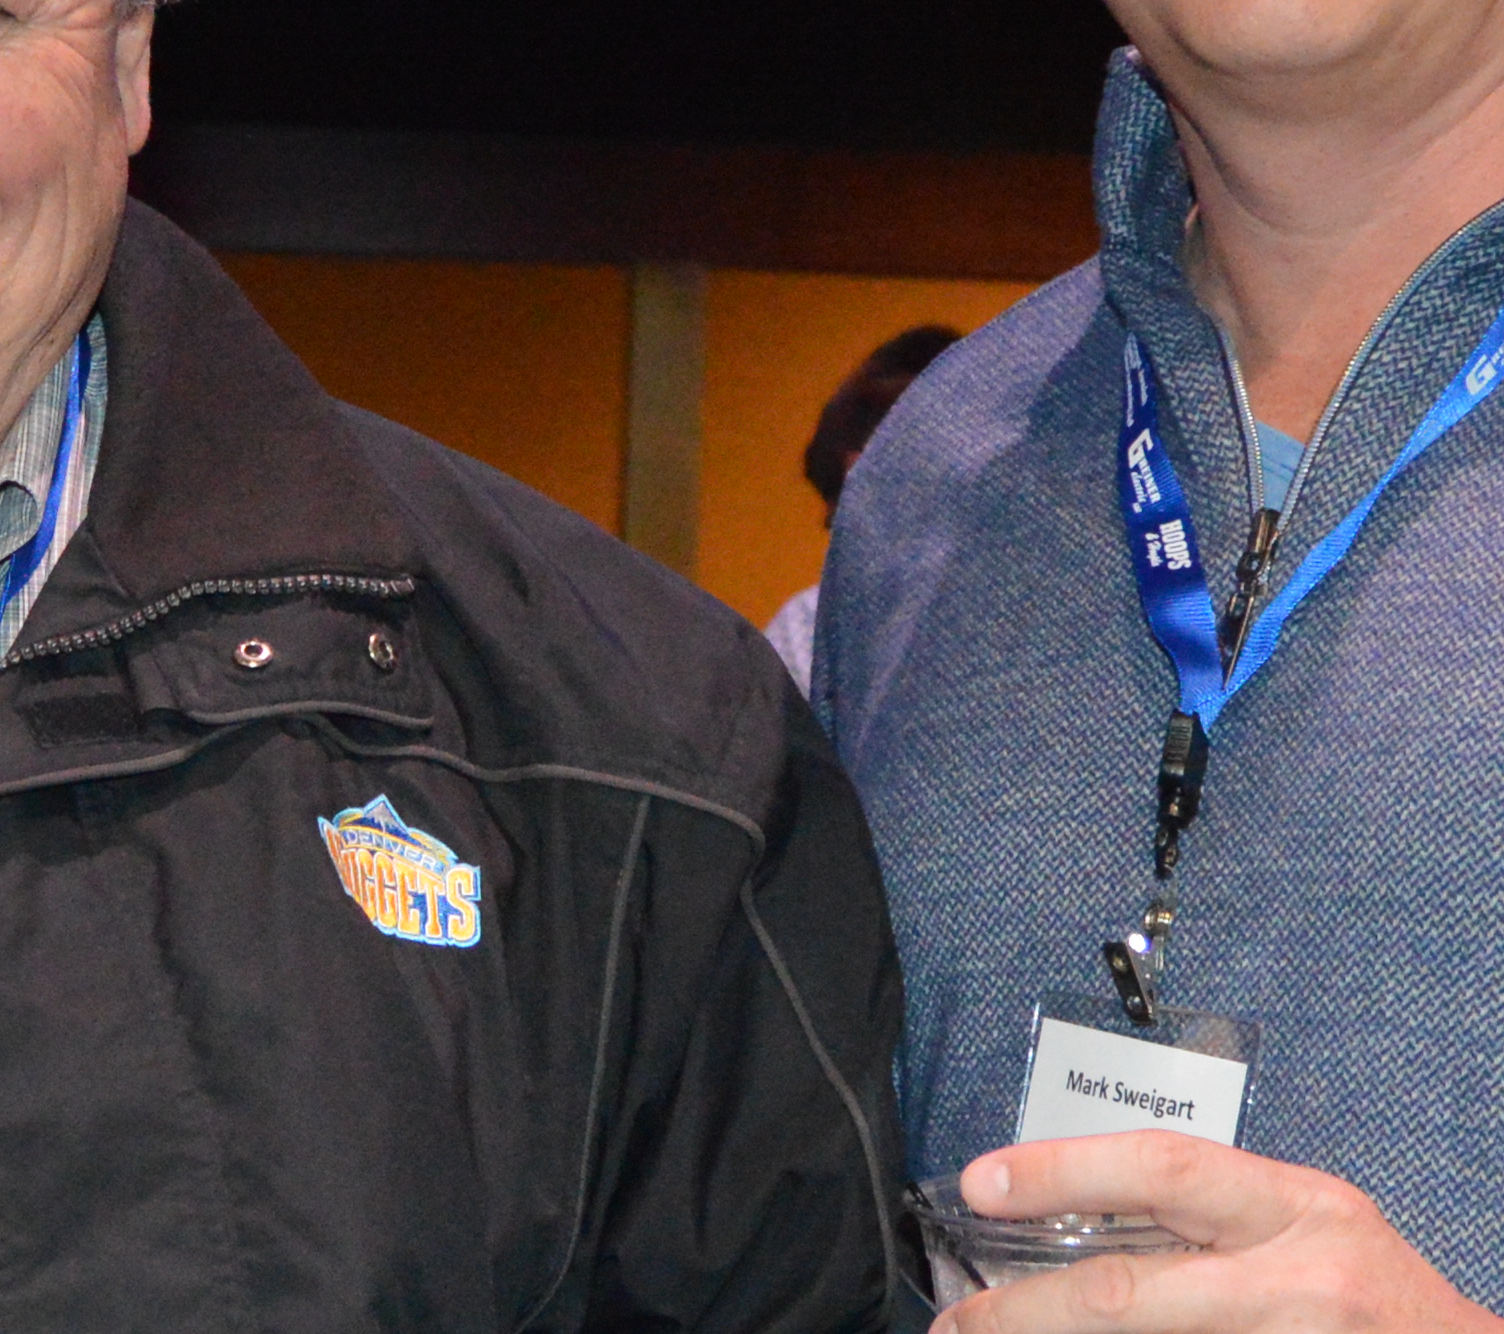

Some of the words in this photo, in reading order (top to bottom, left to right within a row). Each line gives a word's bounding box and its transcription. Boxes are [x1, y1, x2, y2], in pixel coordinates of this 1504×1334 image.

[1128, 428, 1161, 504] GREINER
[1159, 519, 1192, 570] HOOPS
[345, 828, 437, 870] DENVER
[322, 822, 476, 942] NUGGETS
[1065, 1069, 1109, 1100] Mark
[1112, 1081, 1195, 1120] Sweigart
